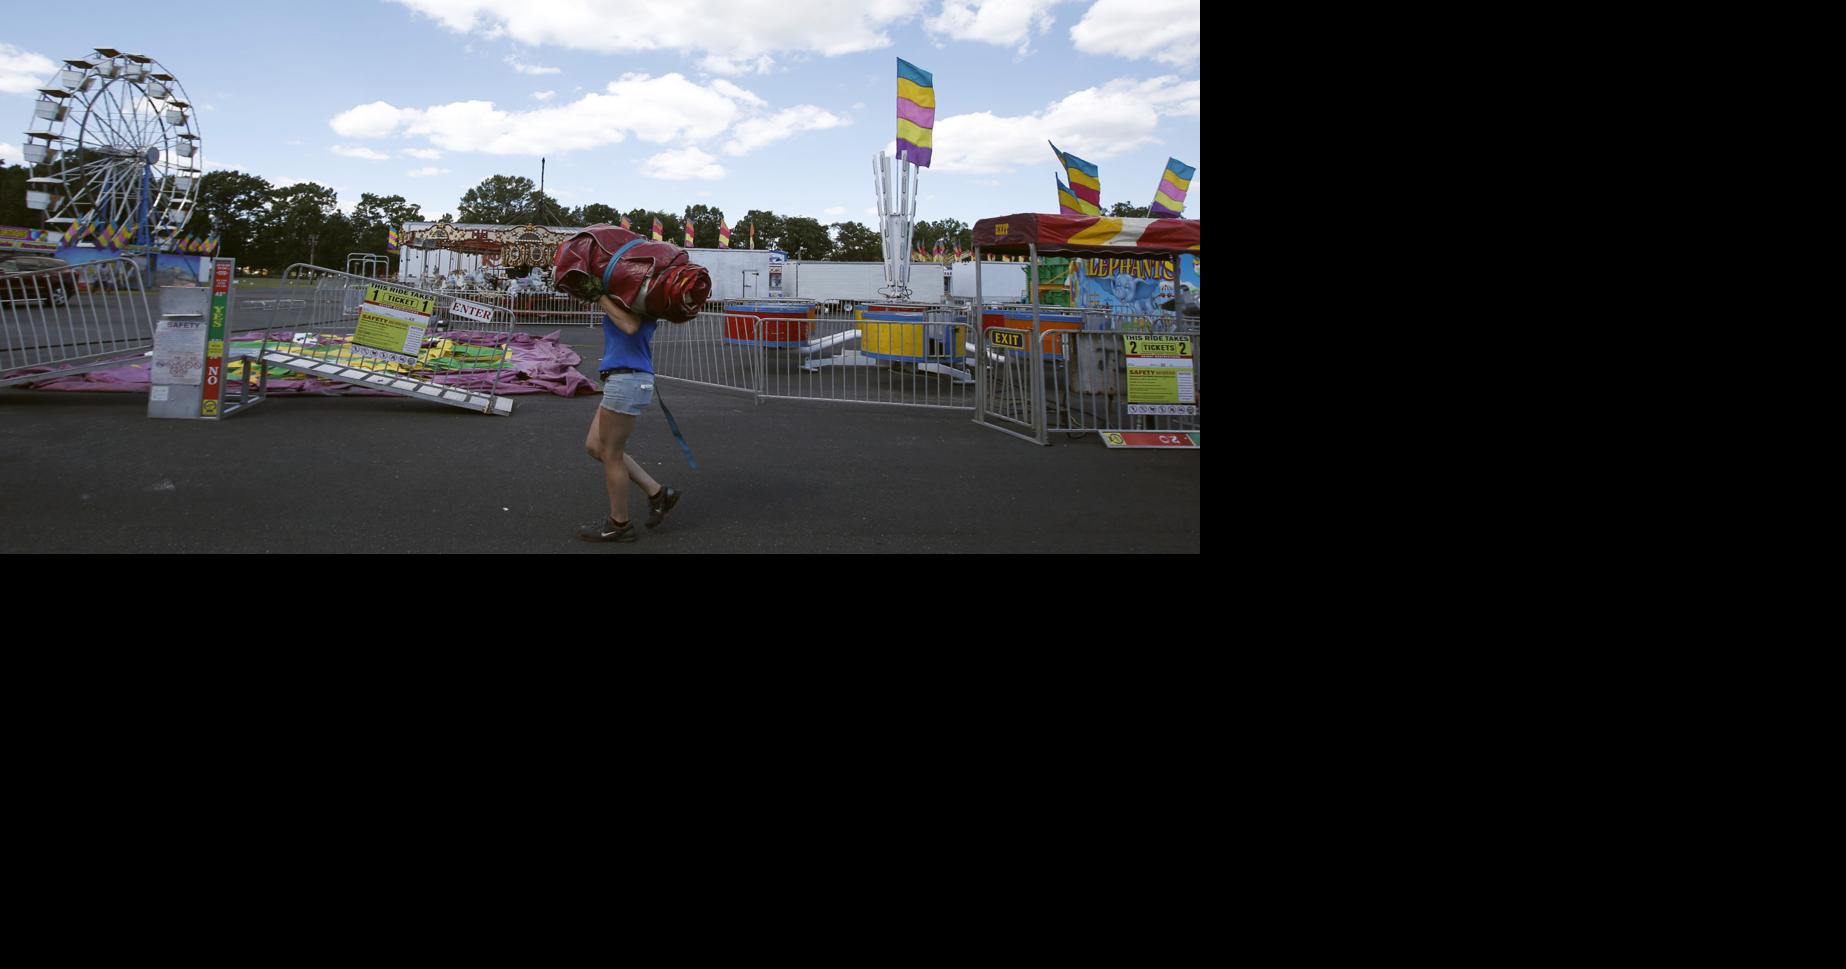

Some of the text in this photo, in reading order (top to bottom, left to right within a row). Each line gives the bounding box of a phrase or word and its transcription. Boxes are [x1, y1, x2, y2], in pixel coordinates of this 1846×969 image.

[995, 223, 1009, 235] EXIT
[371, 283, 434, 301] THIS RIDE TAKES
[373, 290, 379, 301] 1
[387, 295, 415, 306] TICKET
[422, 300, 429, 312] 1
[452, 303, 491, 320] ENTER
[167, 321, 200, 329] SAFETY
[362, 314, 389, 324] SAFETY
[995, 333, 1019, 346] EXIT
[1130, 341, 1187, 354] 2 TICKETS 2
[207, 366, 220, 385] NO
